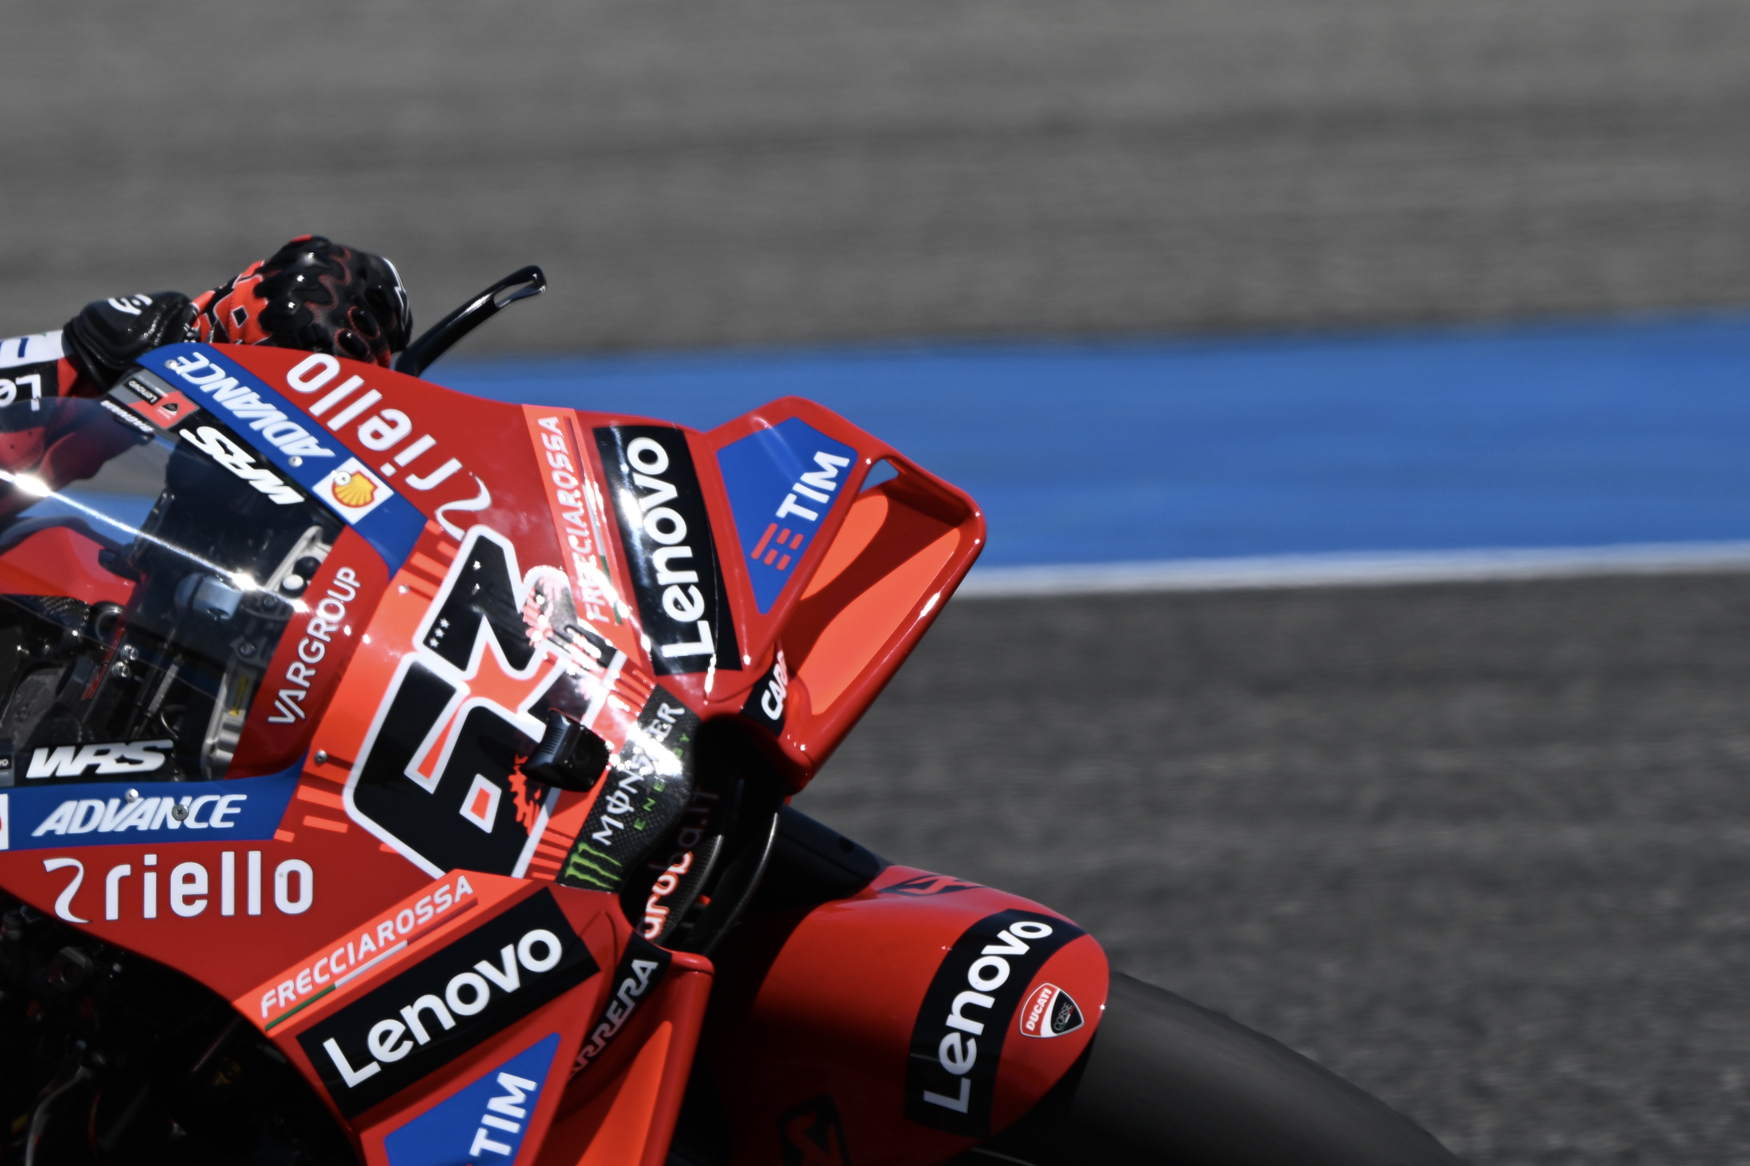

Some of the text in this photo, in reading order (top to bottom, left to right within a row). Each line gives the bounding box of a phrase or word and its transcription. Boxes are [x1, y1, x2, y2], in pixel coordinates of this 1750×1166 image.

[128, 380, 158, 404] Lenovo
[175, 350, 336, 461] ADVANCE
[286, 353, 464, 492] riello
[179, 426, 305, 506] WRS
[776, 449, 851, 523] TIM
[626, 437, 717, 660] Lenovo
[267, 566, 363, 728] VARGROUP
[344, 524, 626, 880] 63
[25, 739, 175, 779] WRS
[32, 794, 248, 837] ADVANCE
[105, 850, 314, 921] riello
[260, 874, 475, 1019] FRECCIAROSSA
[323, 928, 564, 1089] Lenovo
[569, 956, 659, 1078] ARRERA
[923, 920, 1054, 1115] Lenovo
[1025, 988, 1052, 1032] DUCATI
[1053, 1002, 1073, 1031] CORSE
[468, 1072, 538, 1157] TIM
